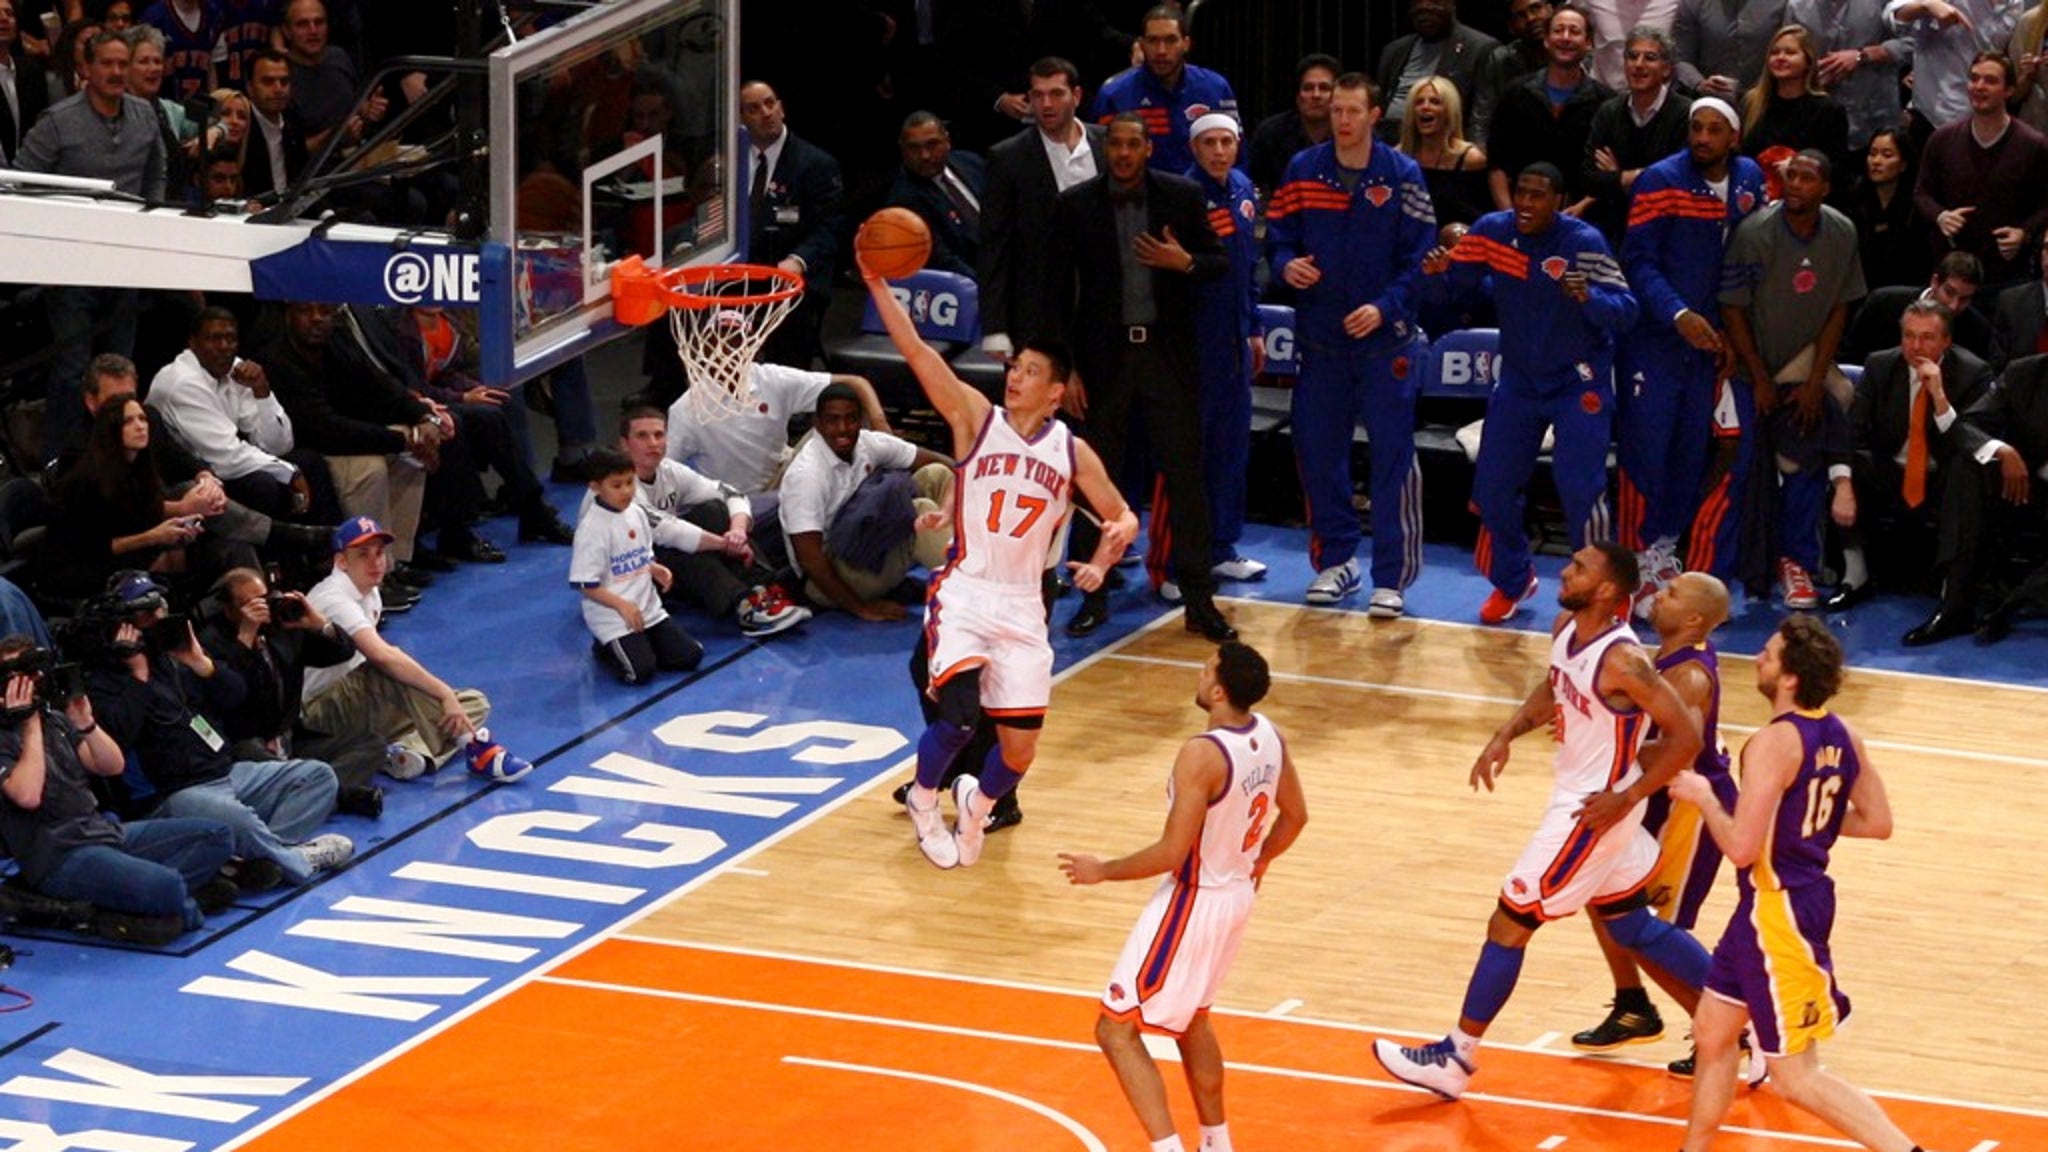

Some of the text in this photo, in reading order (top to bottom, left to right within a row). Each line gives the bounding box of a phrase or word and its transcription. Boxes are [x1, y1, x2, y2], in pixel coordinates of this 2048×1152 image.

[974, 453, 1066, 501] NEW YORK
[986, 489, 1048, 538] 17
[1242, 791, 1269, 853] 2
[1801, 775, 1842, 839] 16
[180, 709, 910, 1022] KNICKS
